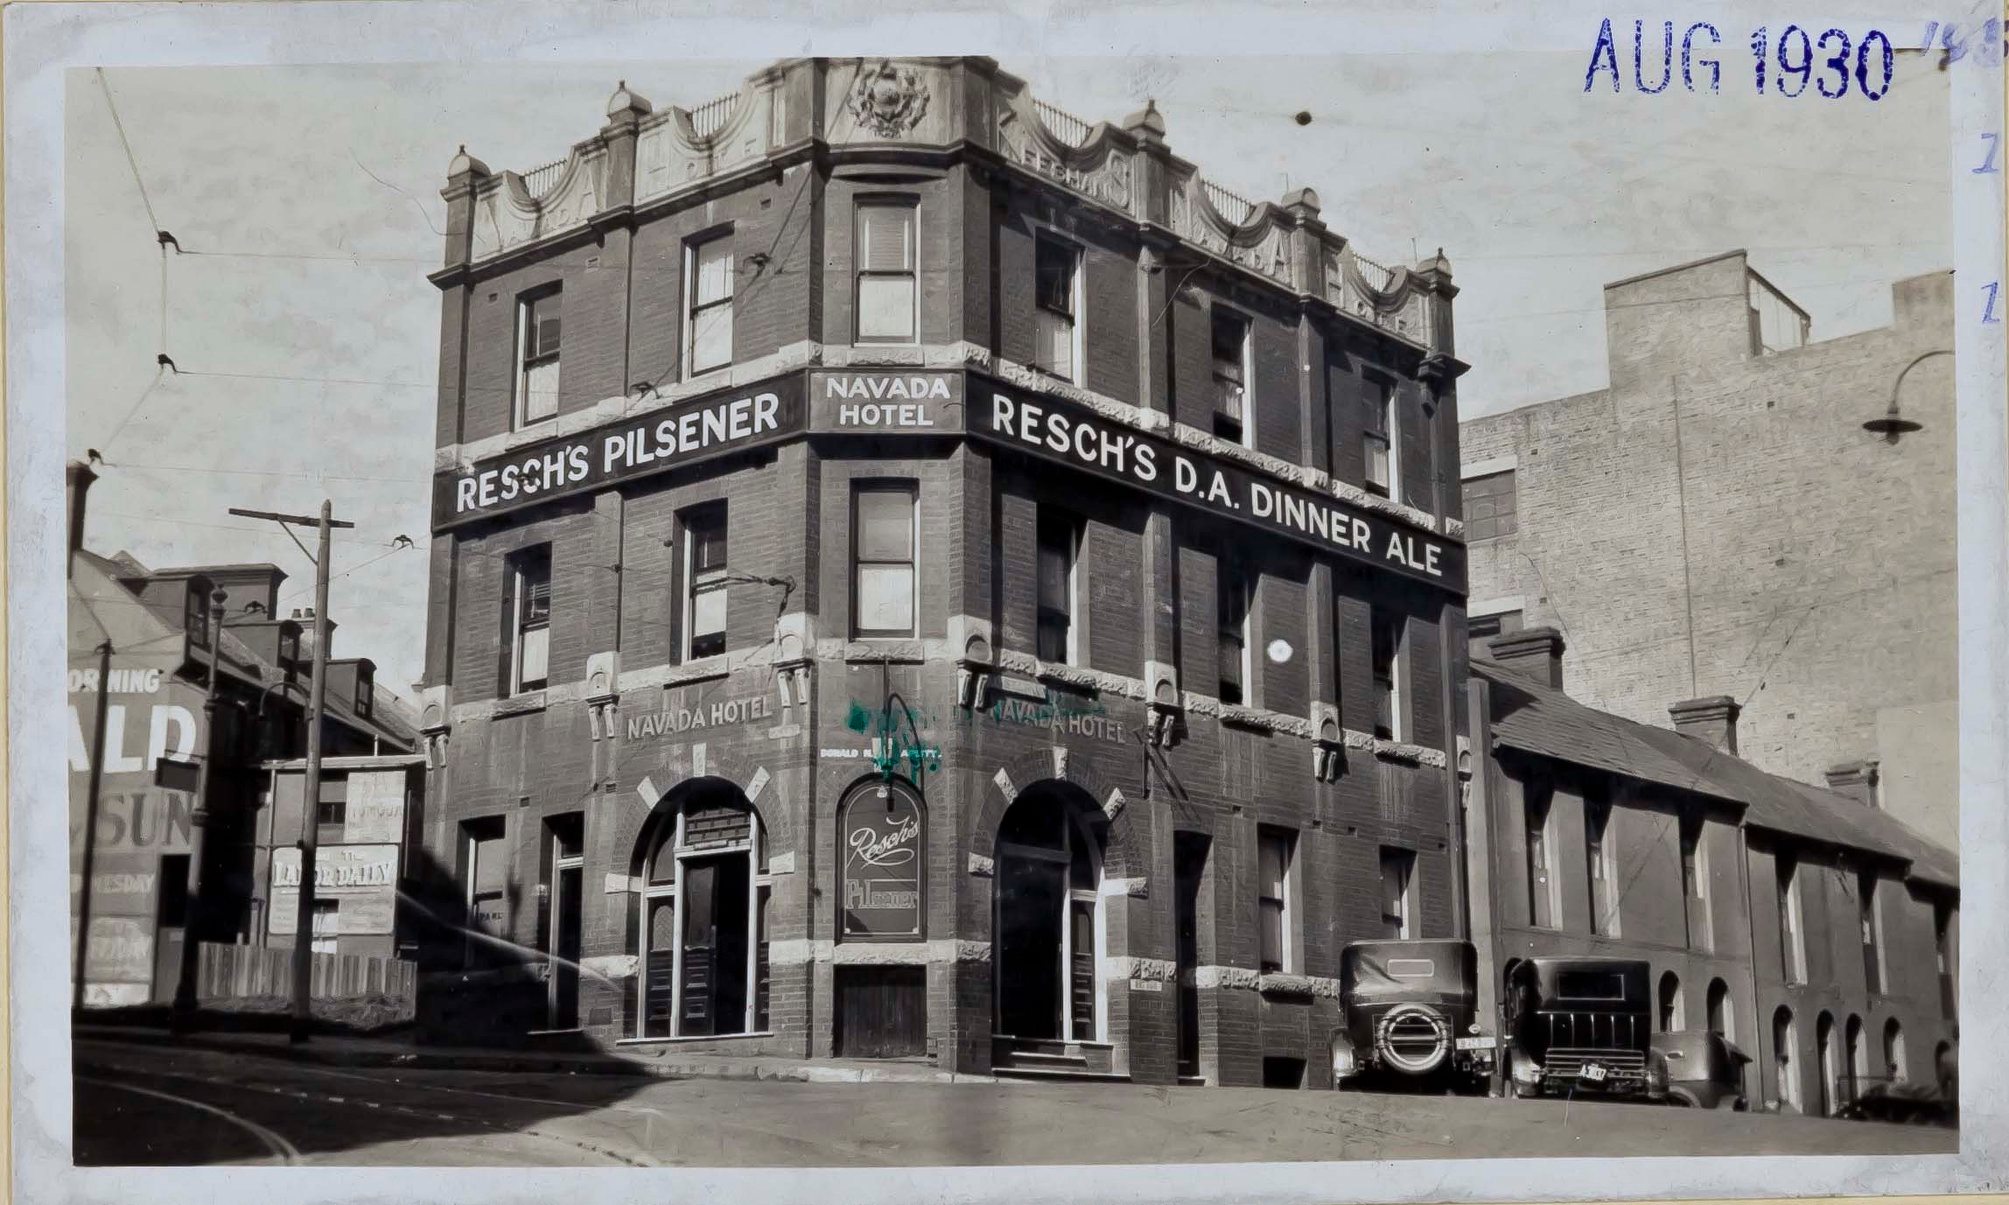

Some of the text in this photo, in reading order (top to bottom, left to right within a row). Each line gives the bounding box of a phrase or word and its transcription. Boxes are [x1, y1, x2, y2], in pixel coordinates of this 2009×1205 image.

[826, 377, 951, 398] NAVADA
[839, 404, 934, 426] HOTEL
[456, 392, 780, 512] RESCH'S PILSENER
[992, 394, 1444, 577] RESCH'S D.A. DINNER ALE
[627, 696, 774, 740] NAVADA HOTEL
[991, 697, 1127, 744] NAVADA HOTEL
